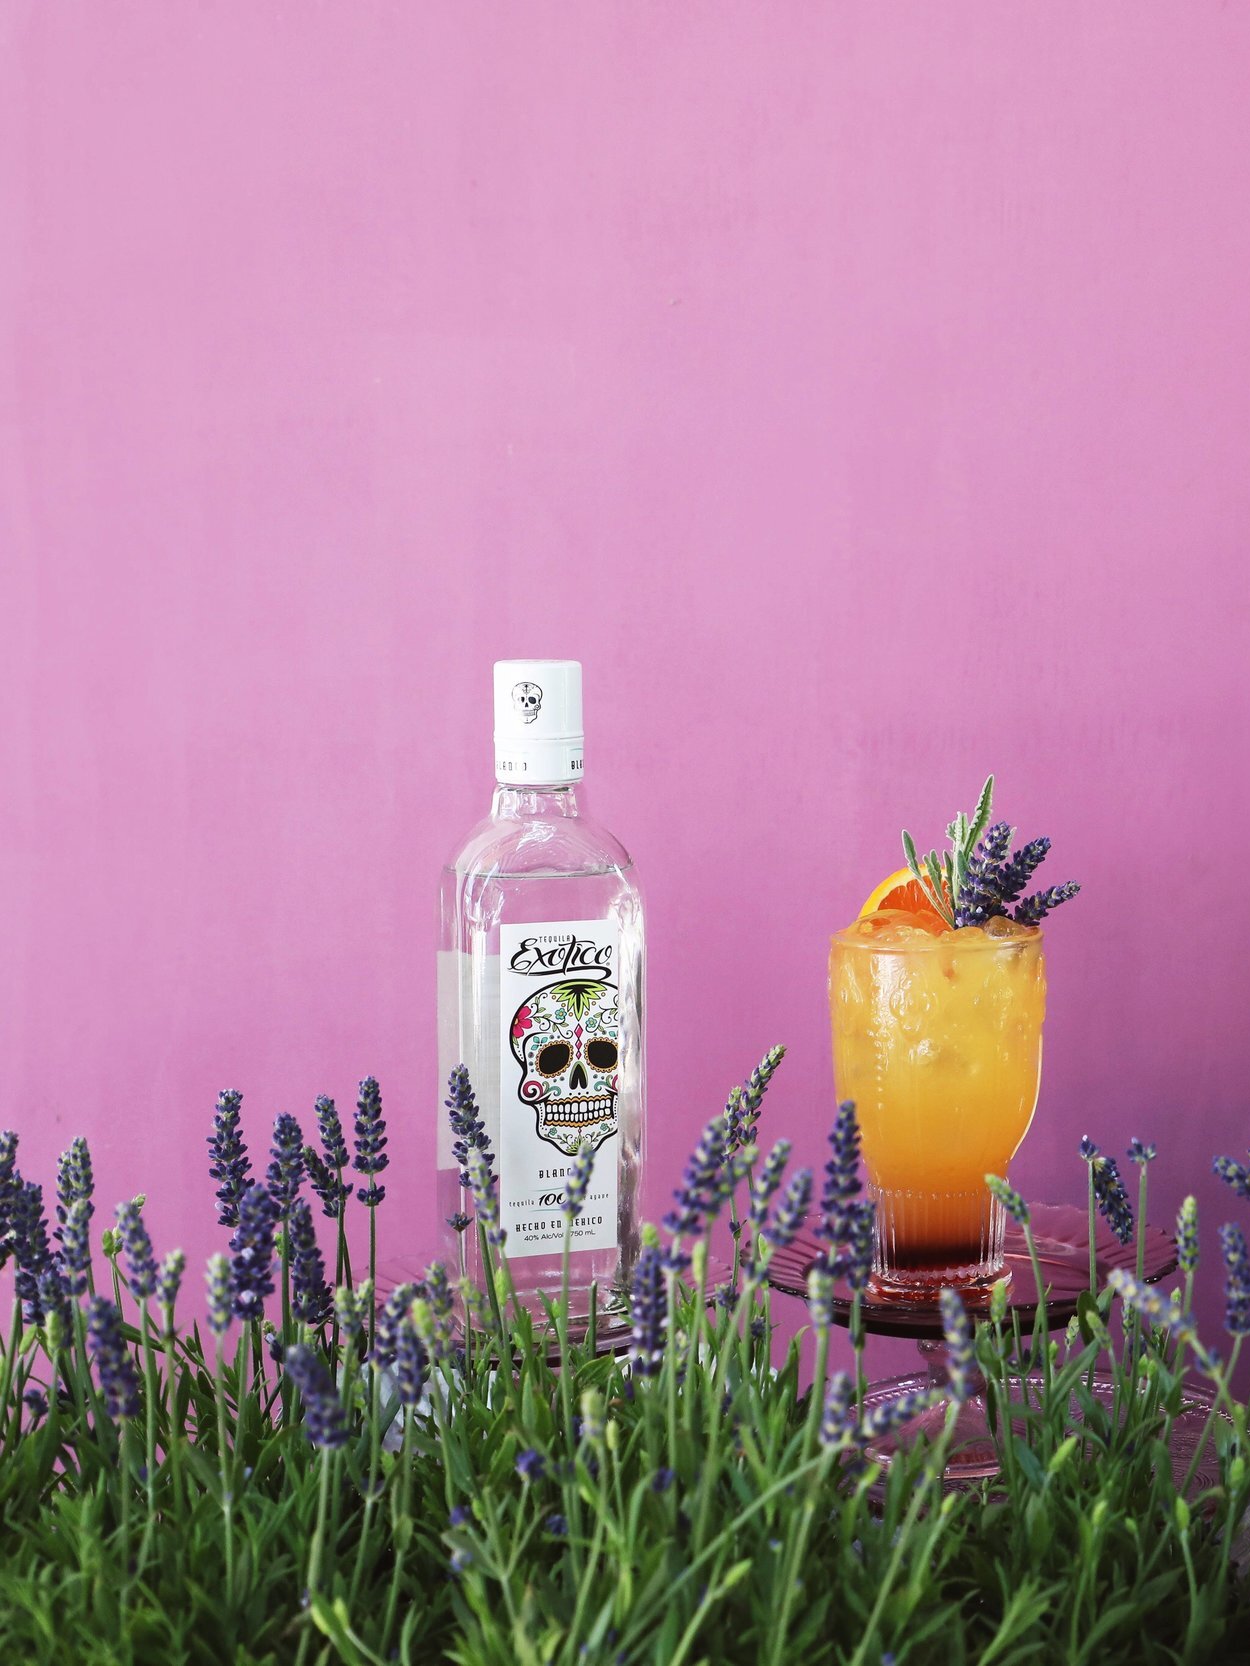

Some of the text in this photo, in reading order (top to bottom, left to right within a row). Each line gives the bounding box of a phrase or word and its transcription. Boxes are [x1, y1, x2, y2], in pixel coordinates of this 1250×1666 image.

[539, 935, 571, 943] TEQUILA
[507, 934, 612, 975] Exotico
[538, 1168, 572, 1179] BLANC
[509, 1199, 535, 1207] tequila
[538, 1193, 567, 1206] 100
[515, 1221, 546, 1232] HECHO
[550, 1220, 562, 1229] EN
[524, 1234, 540, 1242] 40%
